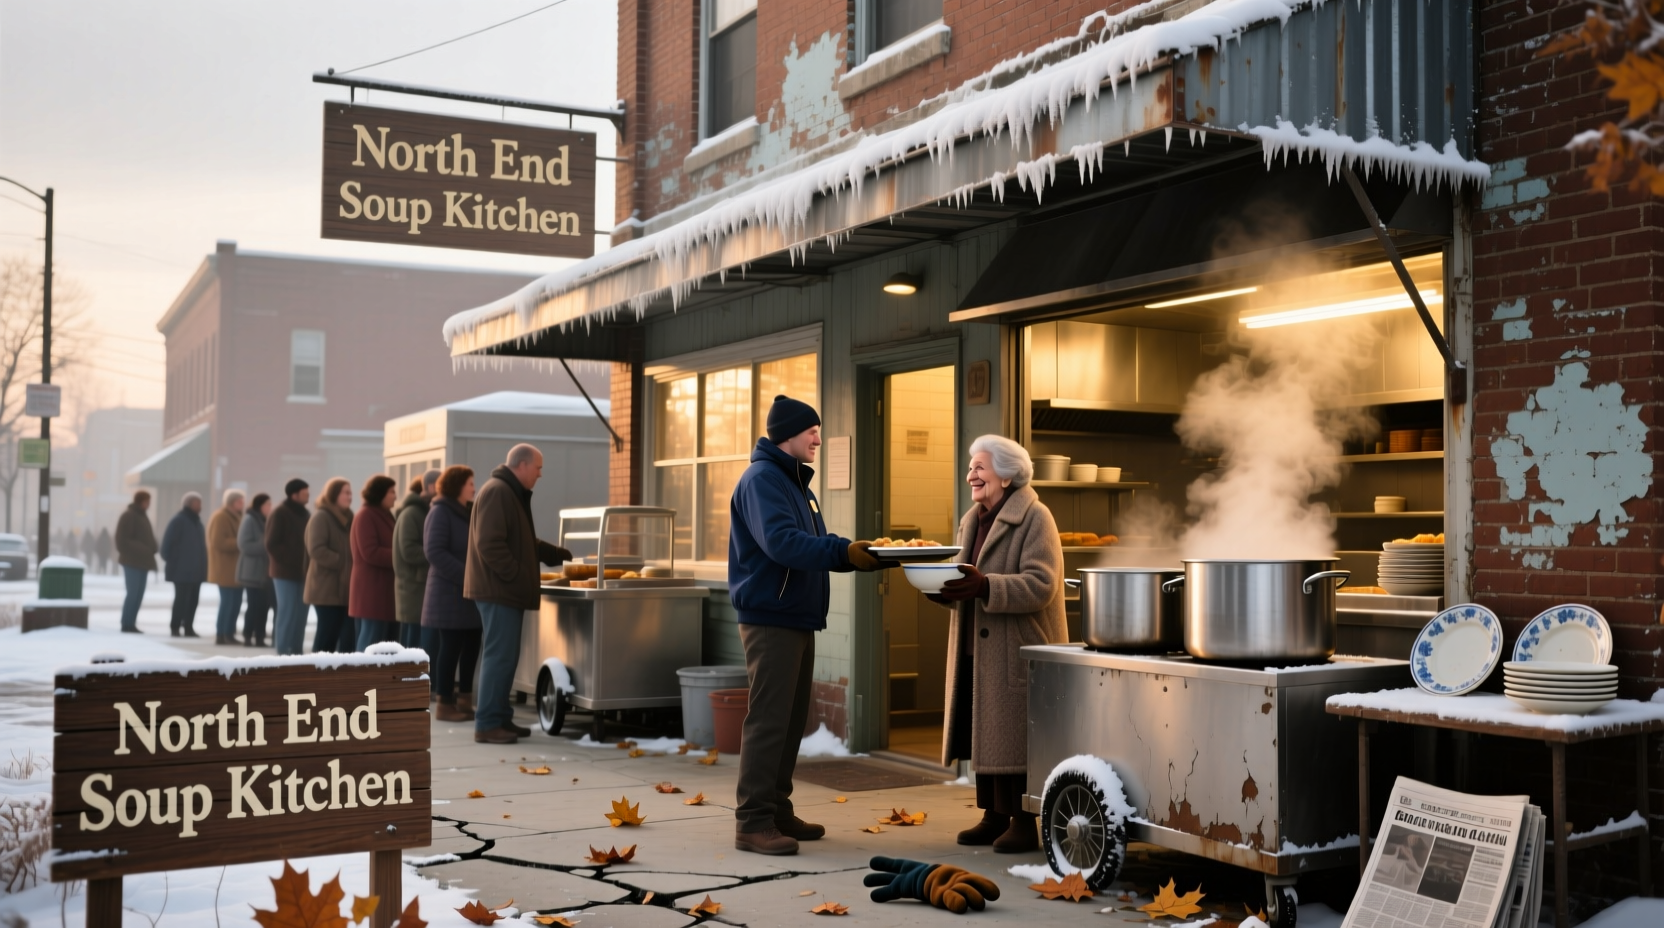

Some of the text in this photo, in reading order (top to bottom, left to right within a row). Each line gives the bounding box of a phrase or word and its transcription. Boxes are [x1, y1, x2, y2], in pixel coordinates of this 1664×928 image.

[352, 124, 572, 186] North End
[339, 180, 582, 237] Soup Kitchen
[113, 688, 382, 756] North End
[79, 758, 414, 838] Soup Kitchen
